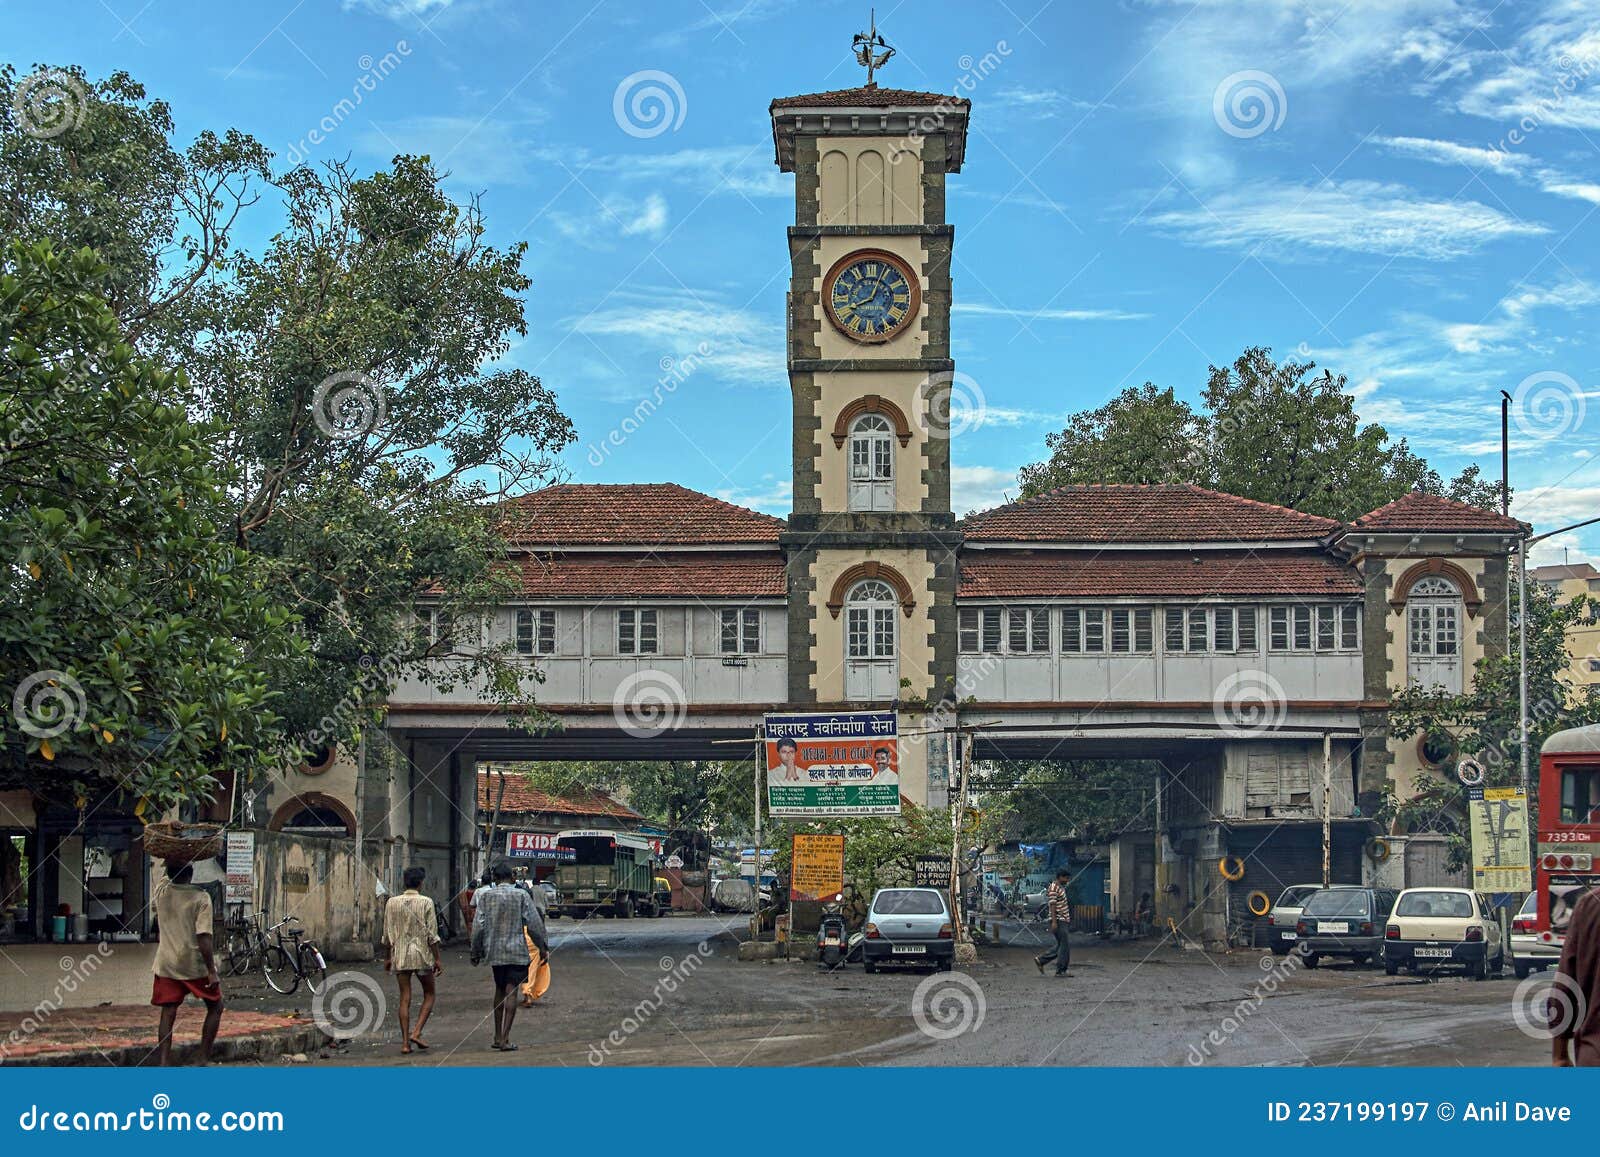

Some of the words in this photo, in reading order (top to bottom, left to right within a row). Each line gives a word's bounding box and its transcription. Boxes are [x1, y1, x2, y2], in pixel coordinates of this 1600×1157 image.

[768, 722, 809, 738] महाराष्ट्र
[813, 716, 866, 735] नवनिर्माण
[870, 716, 894, 734] सेना
[516, 834, 558, 850] EXIDE
[916, 862, 924, 872] NO
[924, 862, 950, 872] PARKING
